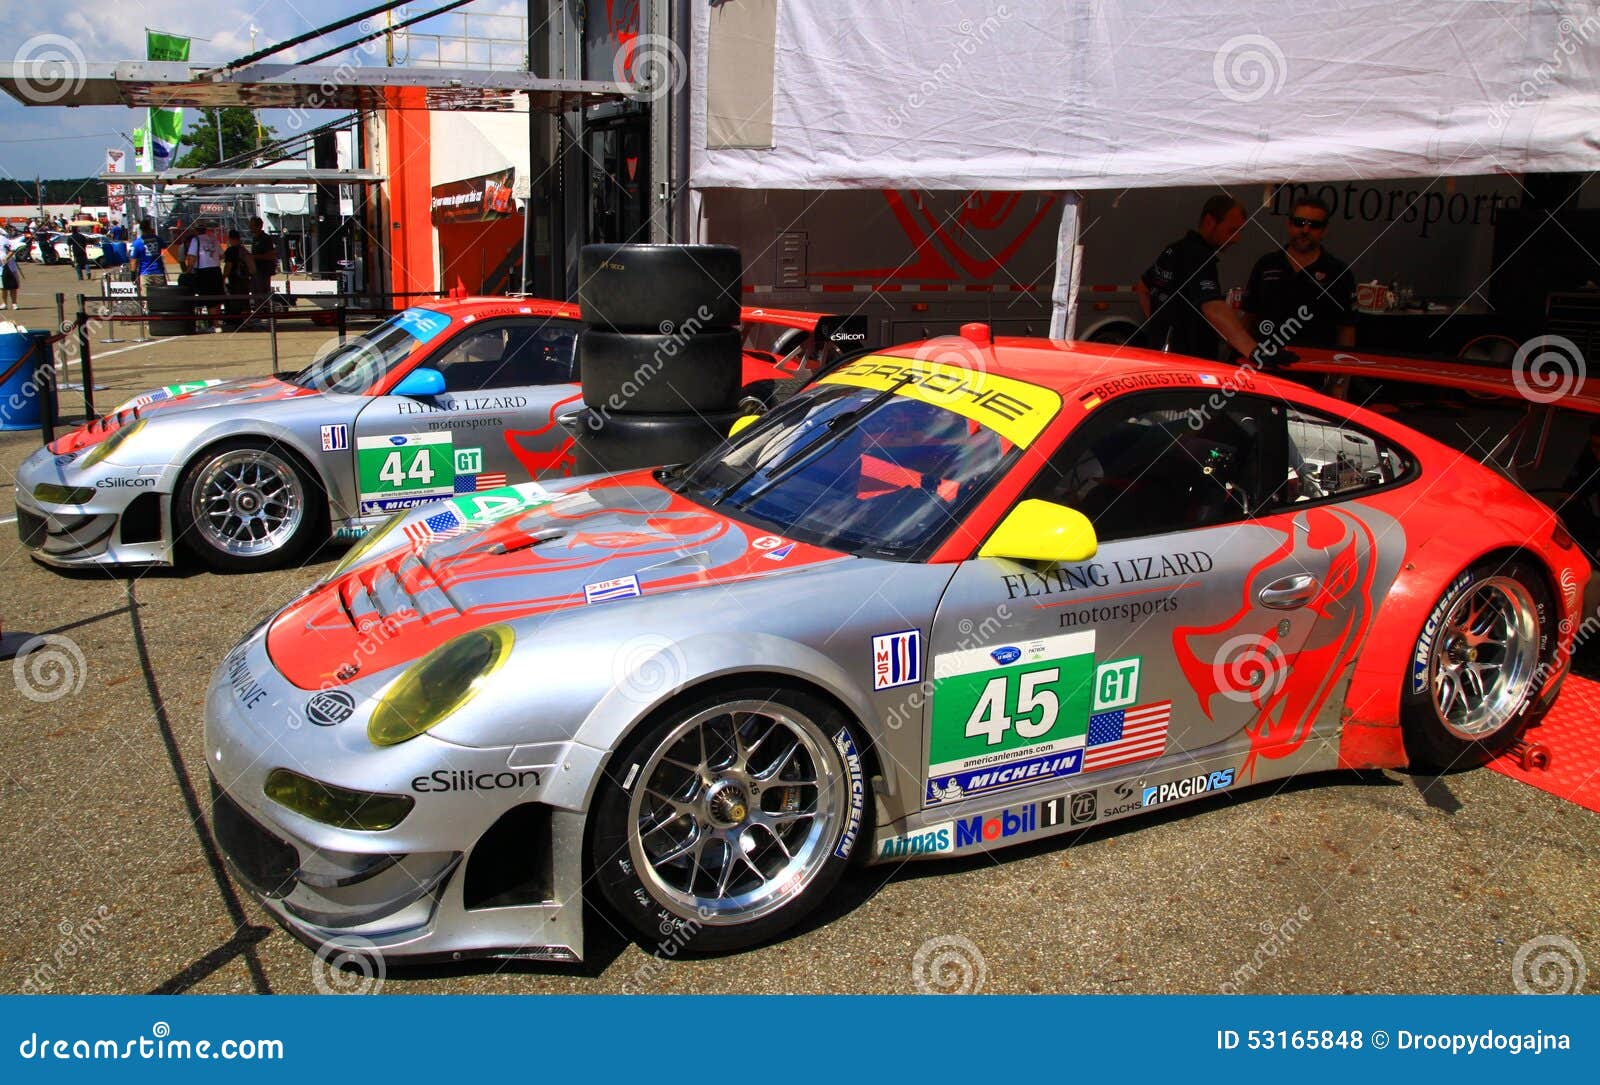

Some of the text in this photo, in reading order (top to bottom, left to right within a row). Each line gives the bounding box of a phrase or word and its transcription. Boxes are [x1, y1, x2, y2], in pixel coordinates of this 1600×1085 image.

[830, 333, 865, 341] eSilicon
[1094, 373, 1195, 400] BERGMEISTER
[397, 397, 527, 415] FLYING LIZARD
[428, 417, 503, 431] motorsports
[378, 449, 435, 487] 44
[457, 452, 479, 472] GT
[96, 477, 156, 488] eSilicon
[1001, 550, 1213, 600] FLYING LIZARD
[1060, 596, 1178, 628] motorsports
[876, 639, 889, 686] IMSA
[1099, 663, 1137, 705] GT
[312, 694, 354, 722] HELLA
[963, 667, 1060, 747] 45
[963, 743, 1054, 769] americanlemans.com
[411, 770, 541, 793] eSilicon
[967, 755, 1076, 790] MICHELIN
[842, 753, 864, 859] MICHELIN
[1103, 801, 1143, 818] SACHS
[956, 804, 1036, 848] Mobil
[879, 828, 950, 858] Airgas
